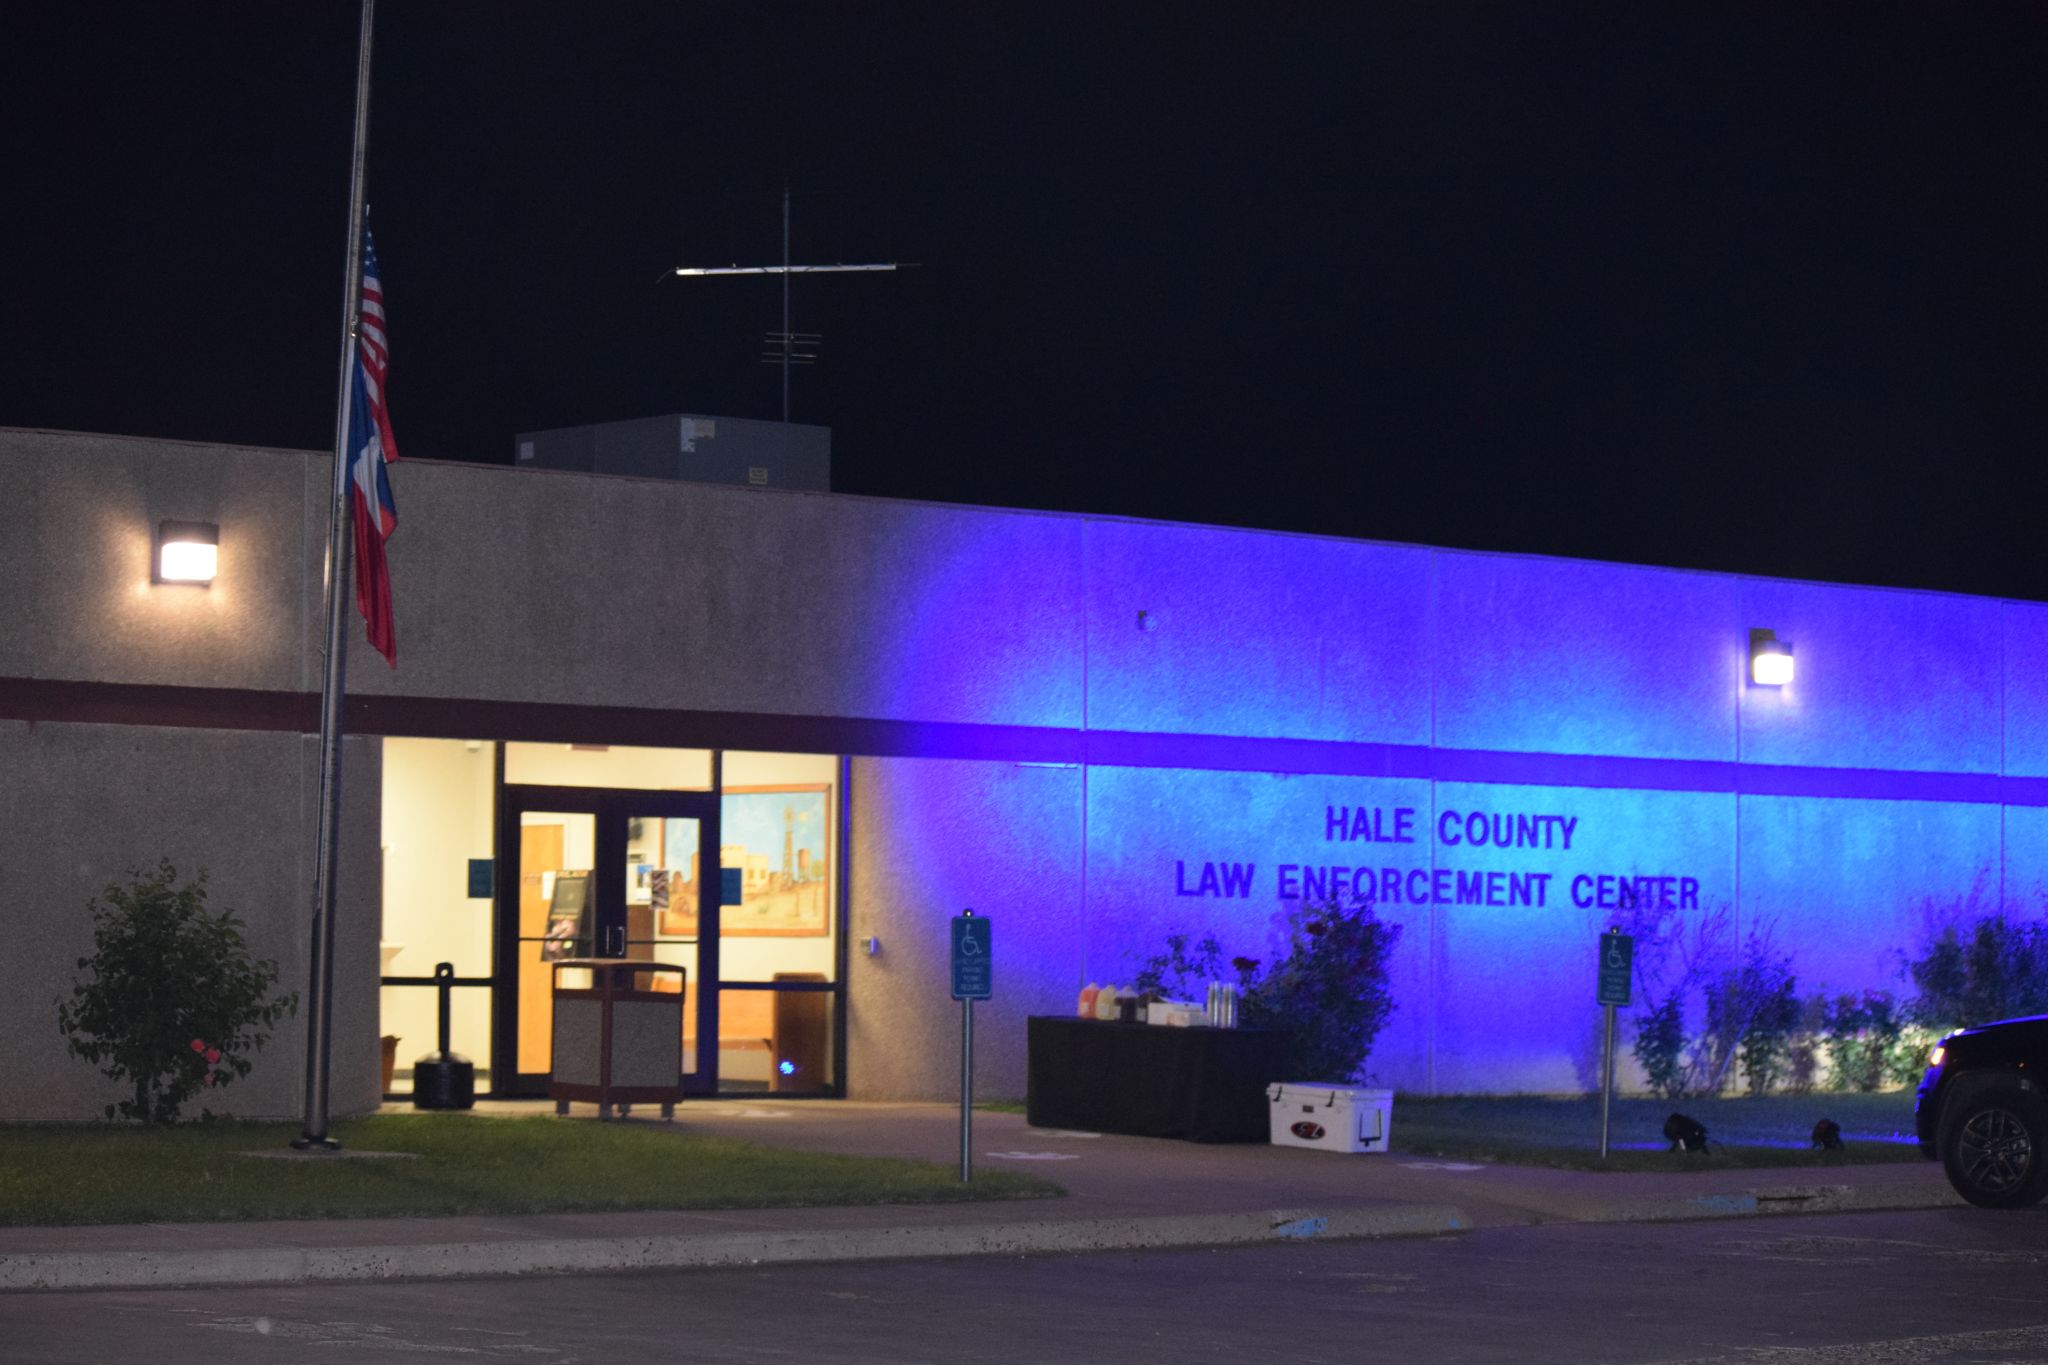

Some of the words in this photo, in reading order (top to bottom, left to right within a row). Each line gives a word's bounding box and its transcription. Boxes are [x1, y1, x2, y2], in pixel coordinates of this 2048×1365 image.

[1325, 805, 1415, 843] HALE
[1438, 810, 1577, 849] COUNTY
[1176, 860, 1255, 898] LAW
[1279, 864, 1552, 907] ENFORCEMENT
[1571, 873, 1699, 910] CENTER
